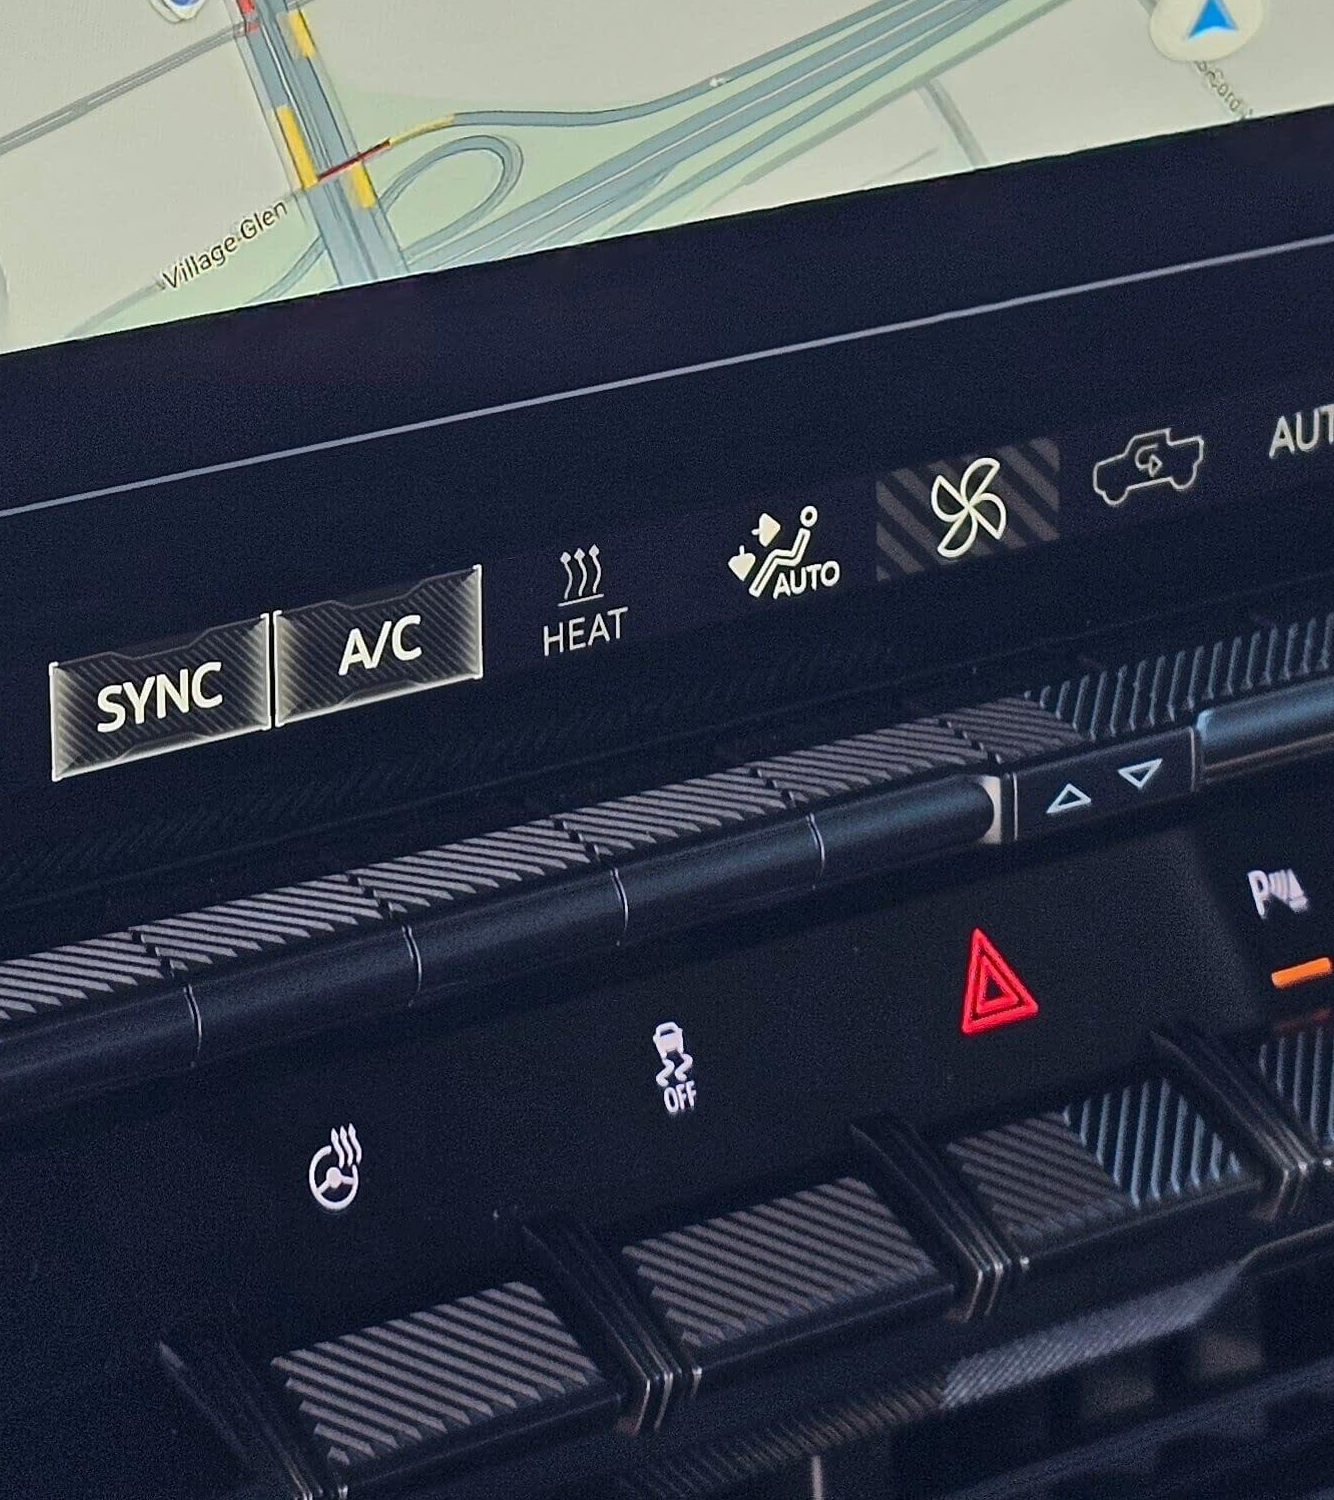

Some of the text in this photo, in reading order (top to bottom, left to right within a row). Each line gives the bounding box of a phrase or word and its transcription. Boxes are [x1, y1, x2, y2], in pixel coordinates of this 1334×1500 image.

[160, 199, 290, 292] Village Glen
[772, 560, 841, 600] AUTO
[542, 606, 629, 657] HEAT
[96, 614, 424, 735] SYNC A/C
[663, 1080, 697, 1114] OFF
